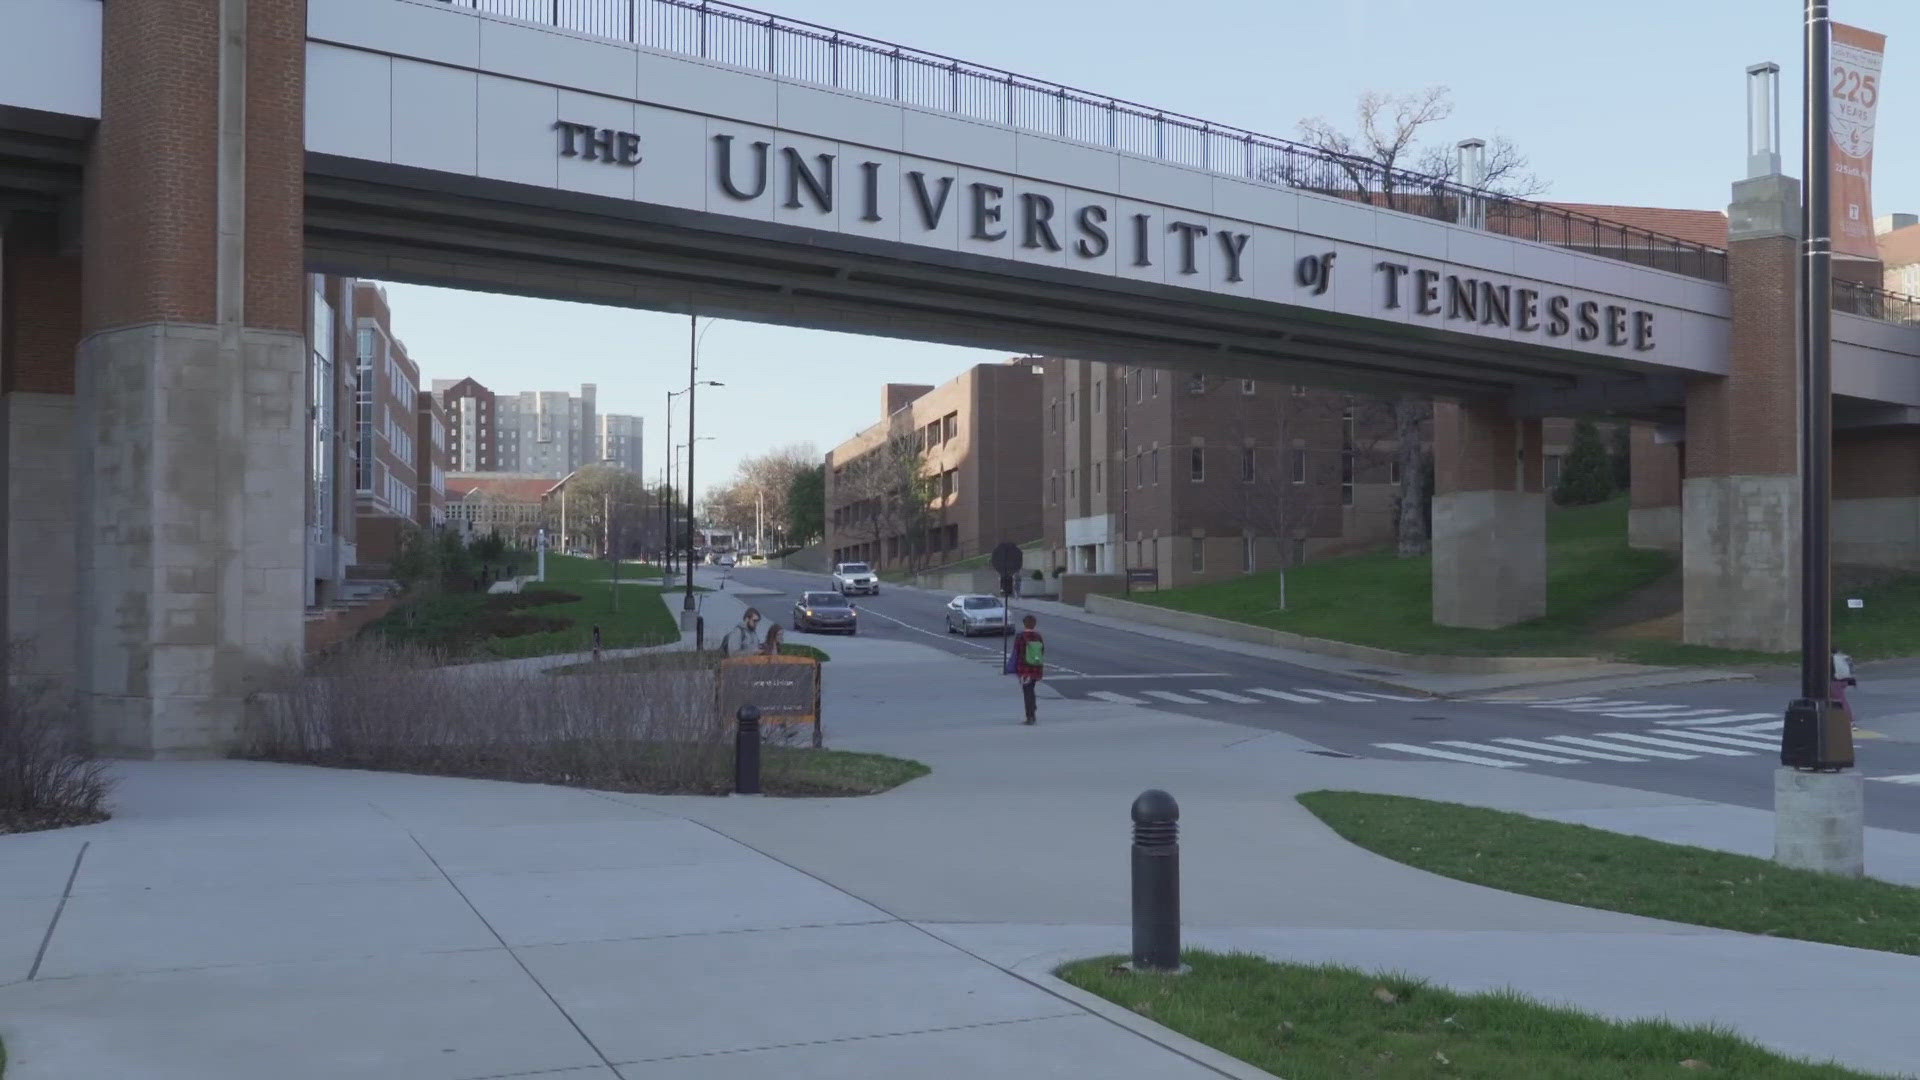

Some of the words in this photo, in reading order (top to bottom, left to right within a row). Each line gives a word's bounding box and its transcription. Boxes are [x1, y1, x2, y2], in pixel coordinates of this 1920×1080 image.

[1832, 65, 1877, 108] 225
[1840, 103, 1868, 120] YEARS
[554, 119, 643, 167] THE
[713, 134, 1250, 282] UNIVERSITY
[1298, 251, 1337, 296] of
[1375, 261, 1656, 352] TENNESSEE
